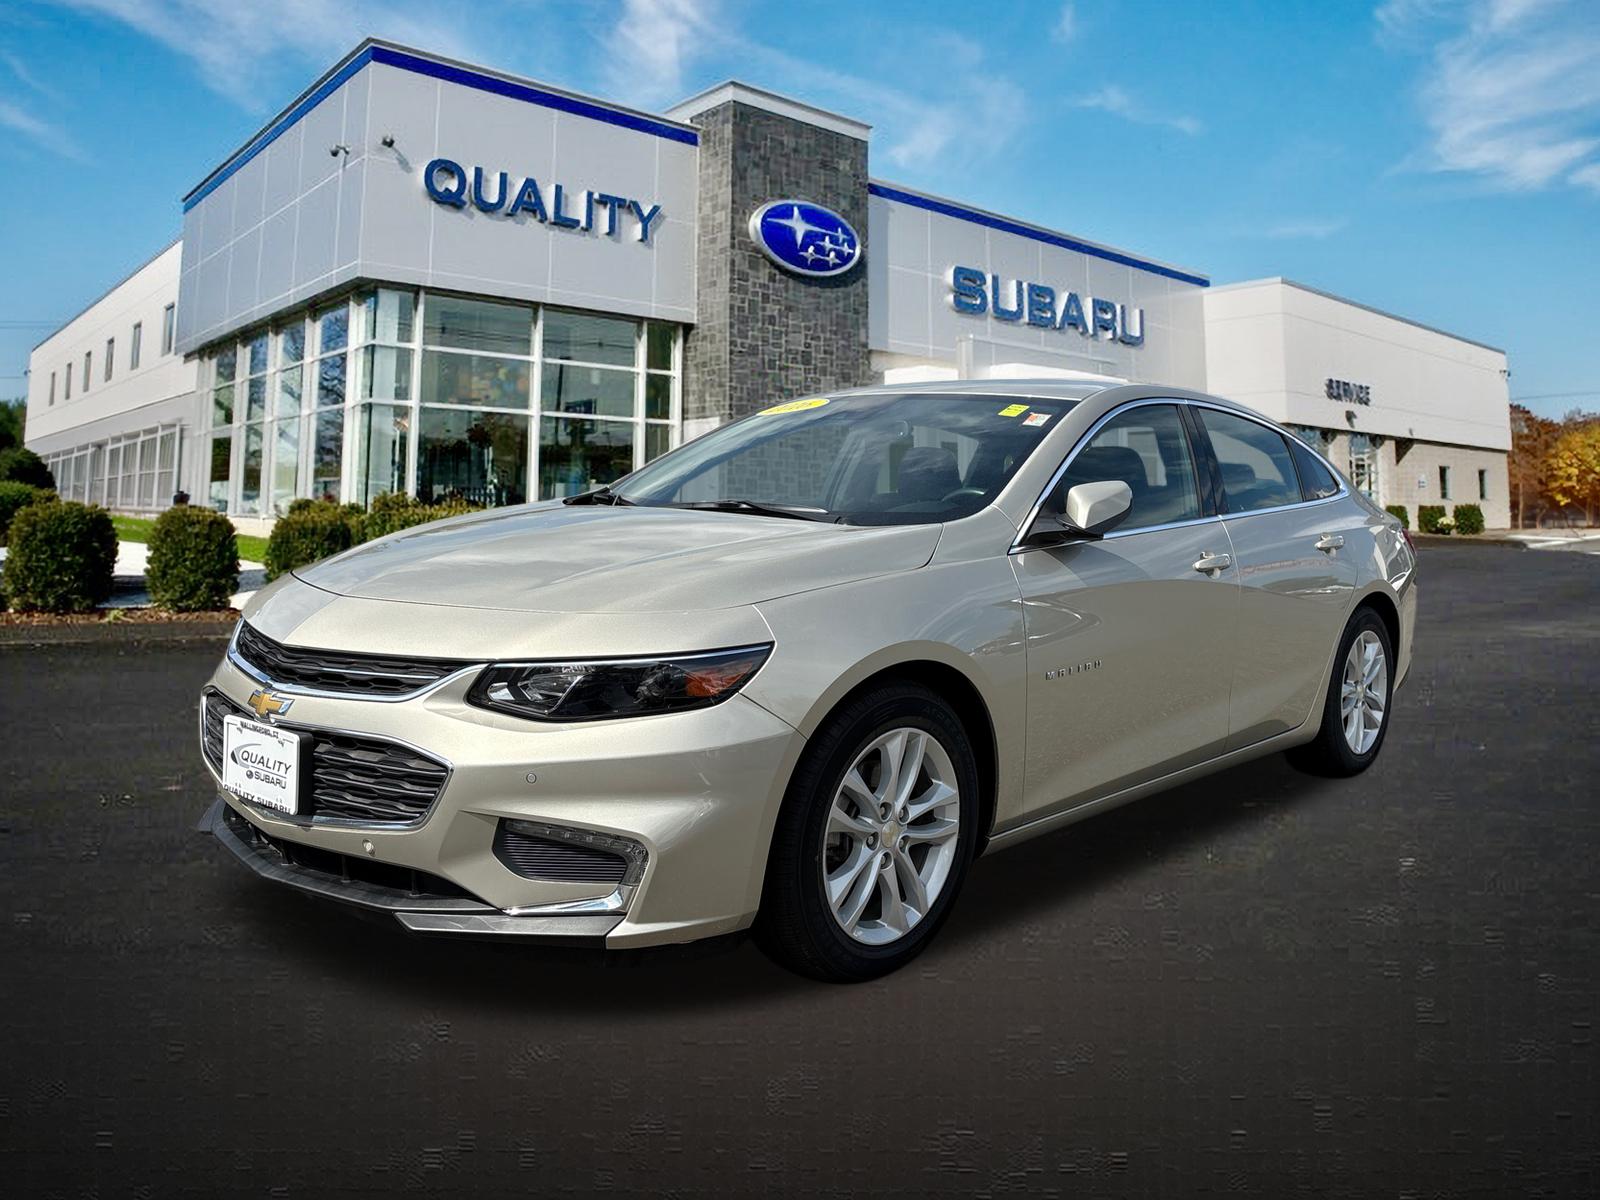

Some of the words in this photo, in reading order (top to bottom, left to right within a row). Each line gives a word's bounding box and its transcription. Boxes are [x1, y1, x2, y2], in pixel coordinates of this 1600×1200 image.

[424, 158, 661, 243] QUALITY
[949, 265, 1145, 346] SUBARU
[1326, 378, 1370, 406] SERVICE
[241, 750, 291, 775] QUALITY
[254, 771, 286, 789] SUBARU
[224, 784, 255, 800] QUALITY
[257, 797, 291, 814] SUBARU
